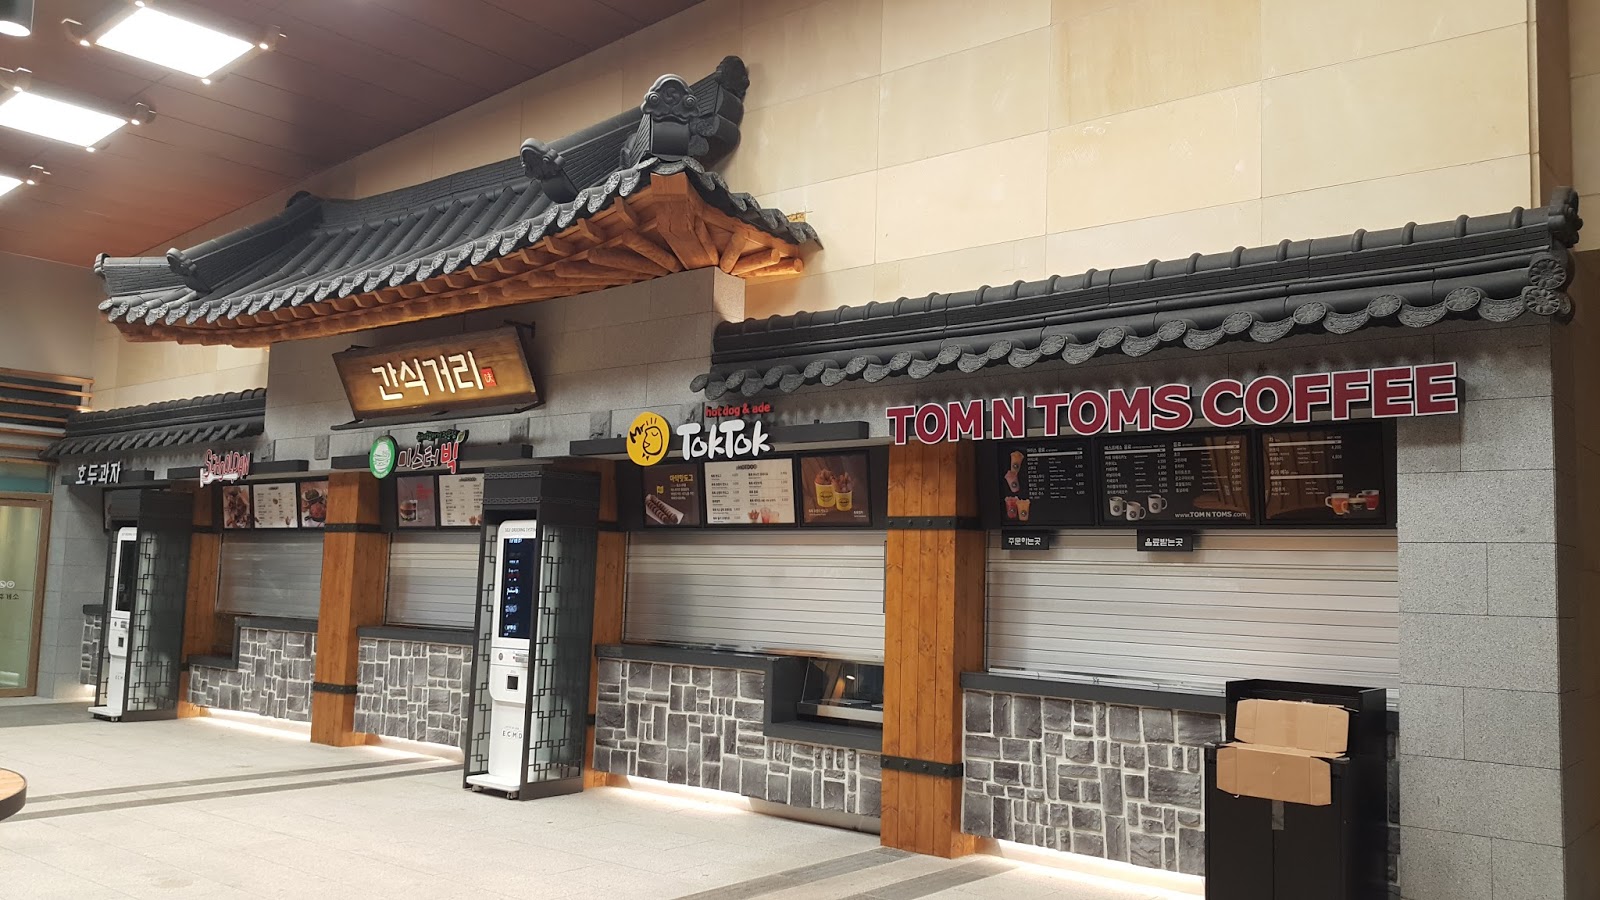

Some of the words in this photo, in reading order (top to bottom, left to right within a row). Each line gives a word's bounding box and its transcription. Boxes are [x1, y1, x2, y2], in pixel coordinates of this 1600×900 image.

[371, 351, 484, 400] 간식거리
[705, 405, 741, 418] hotdog
[742, 403, 749, 414] &
[752, 403, 771, 414] ade
[886, 398, 984, 446] TOM
[991, 395, 1025, 440] N
[1033, 383, 1194, 436] TOMS
[1200, 361, 1460, 429] COFFEE
[676, 419, 771, 461] TokTok
[75, 461, 121, 486] 호두과자
